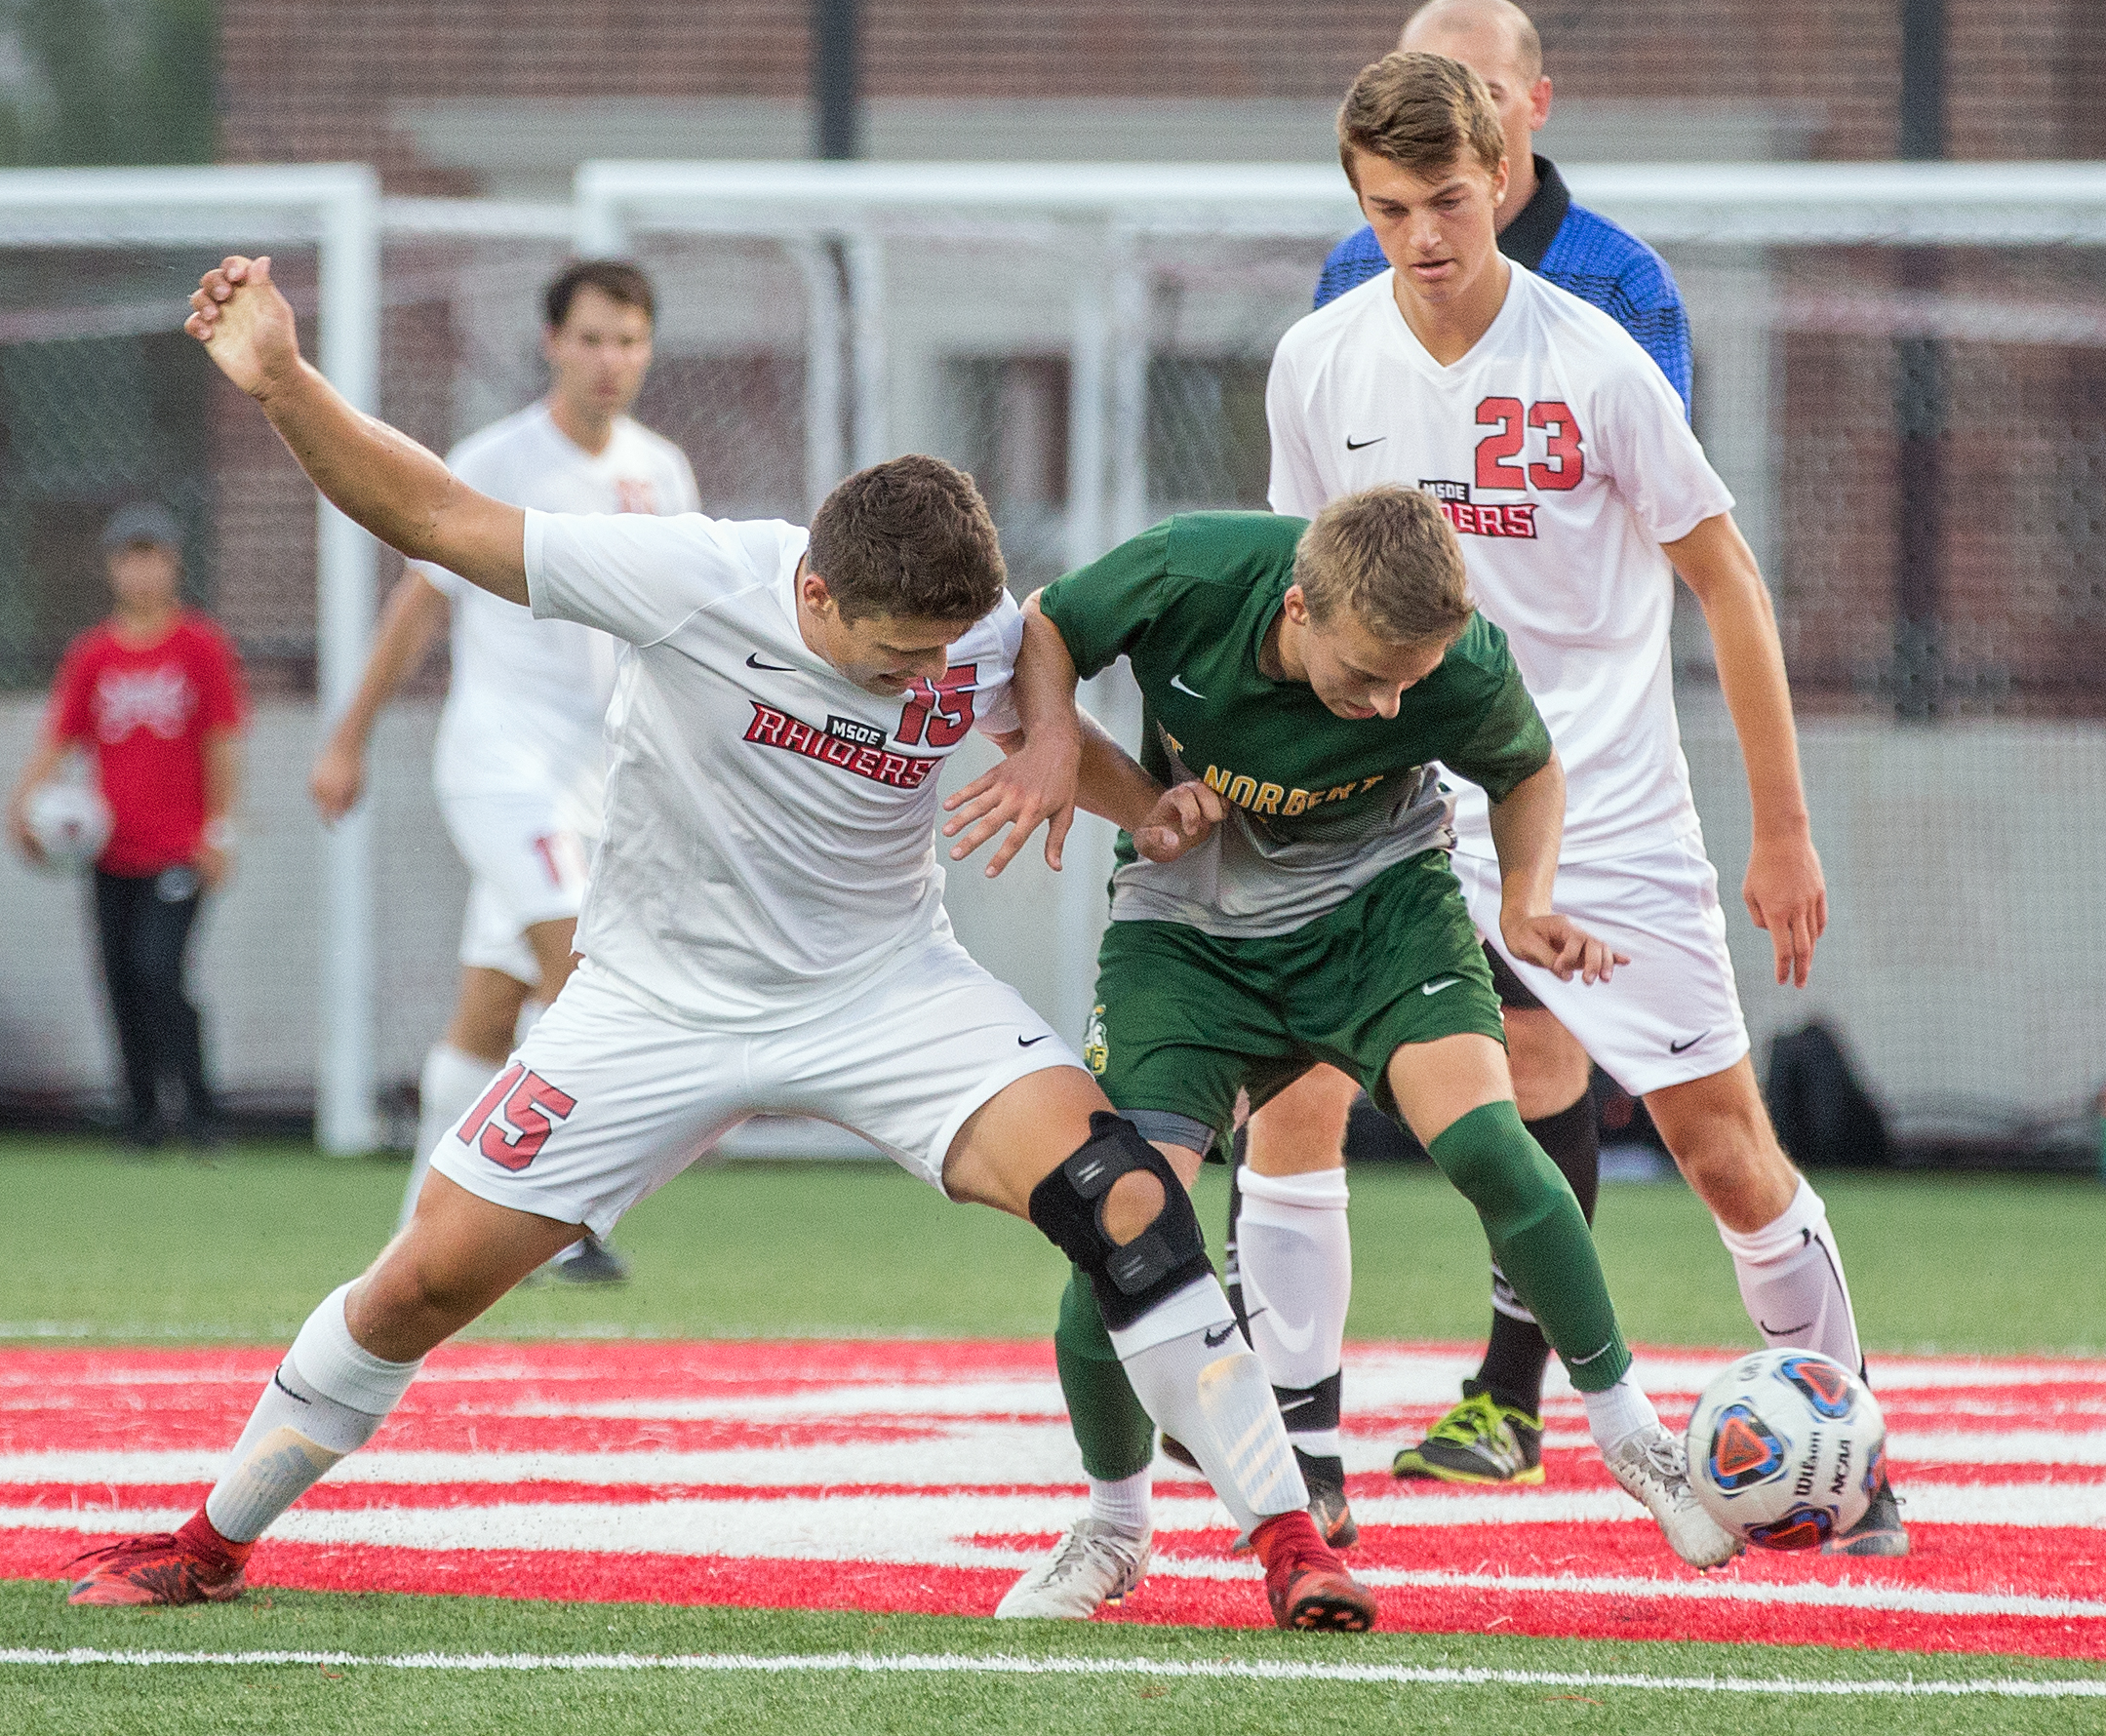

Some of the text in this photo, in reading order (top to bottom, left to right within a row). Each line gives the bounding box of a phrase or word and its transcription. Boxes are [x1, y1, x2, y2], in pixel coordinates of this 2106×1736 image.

[1474, 395, 1585, 491] 23
[747, 704, 937, 786] RAIDERS
[830, 719, 882, 746] MSOE
[893, 663, 978, 748] 15
[456, 1060, 578, 1173] 15
[1794, 1430, 1821, 1496] Wilson
[1829, 1438, 1852, 1496] NCAA
